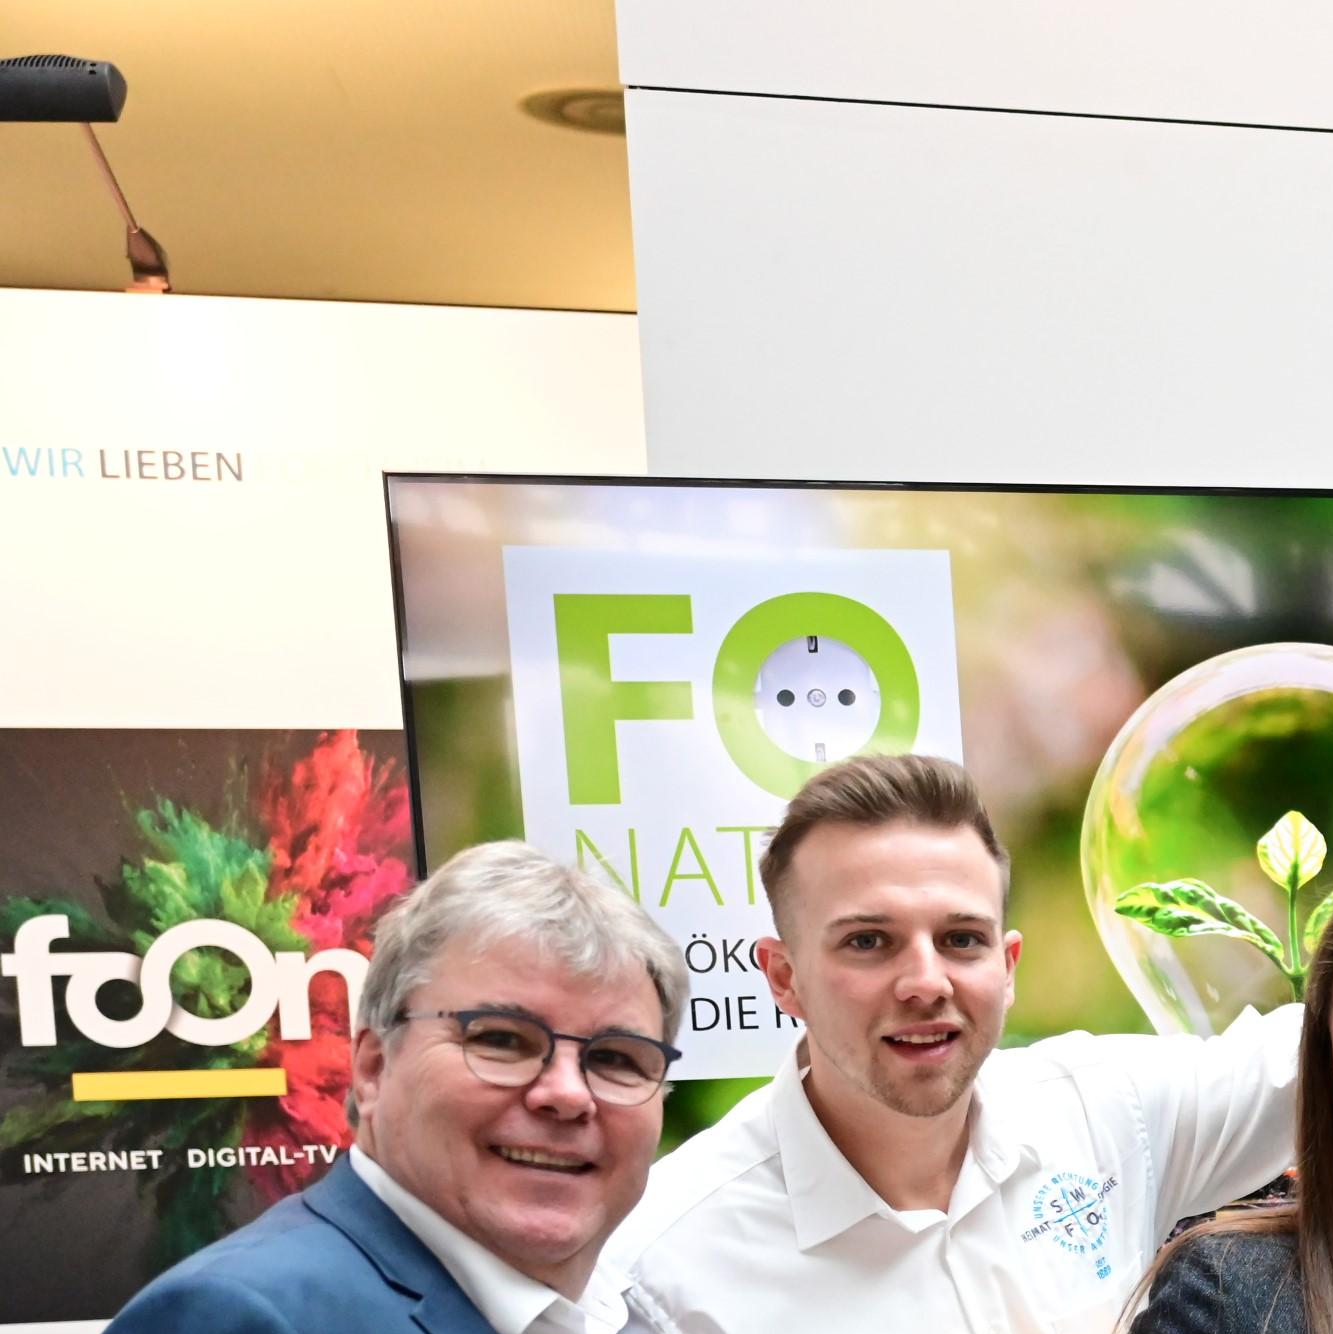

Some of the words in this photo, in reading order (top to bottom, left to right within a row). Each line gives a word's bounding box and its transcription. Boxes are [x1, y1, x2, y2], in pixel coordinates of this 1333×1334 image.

[2, 446, 85, 478] WIR
[99, 448, 244, 482] LIEBEN
[553, 590, 921, 806] FO
[690, 995, 759, 1032] DIE
[24, 1149, 163, 1174] INTERNET
[187, 1145, 338, 1169] DIGITAL-TV
